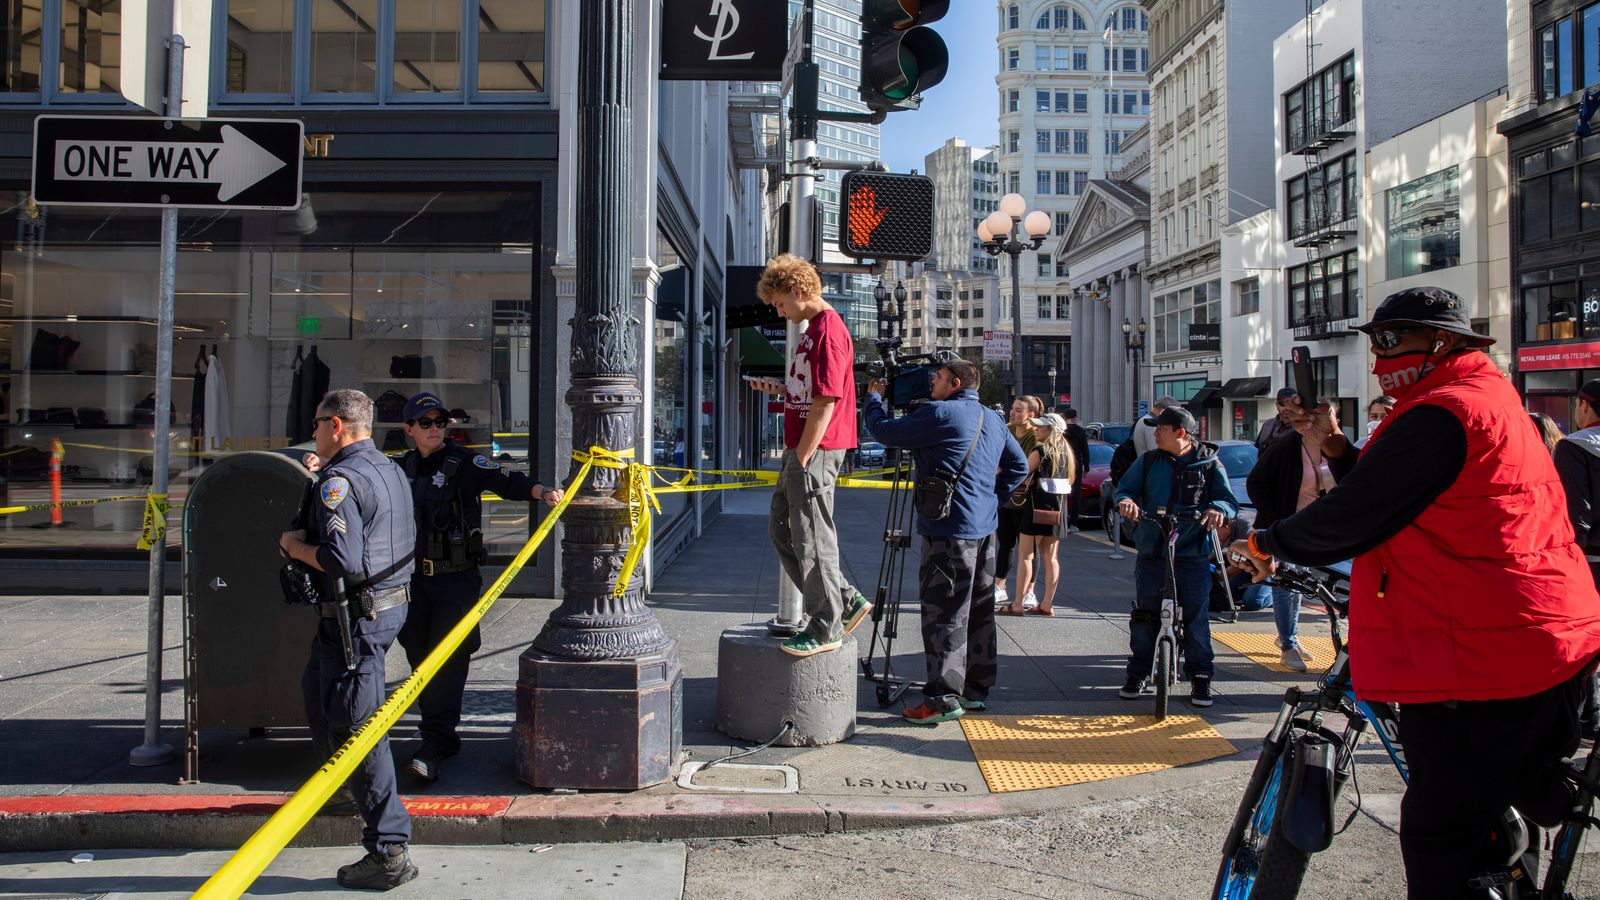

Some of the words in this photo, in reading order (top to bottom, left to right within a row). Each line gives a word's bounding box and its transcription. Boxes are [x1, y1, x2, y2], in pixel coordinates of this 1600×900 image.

[63, 144, 133, 178] ONE
[147, 146, 220, 180] WAY
[984, 331, 993, 340] NO
[1189, 333, 1206, 341] cinta
[631, 505, 640, 524] NOT
[405, 802, 468, 810] FMTA
